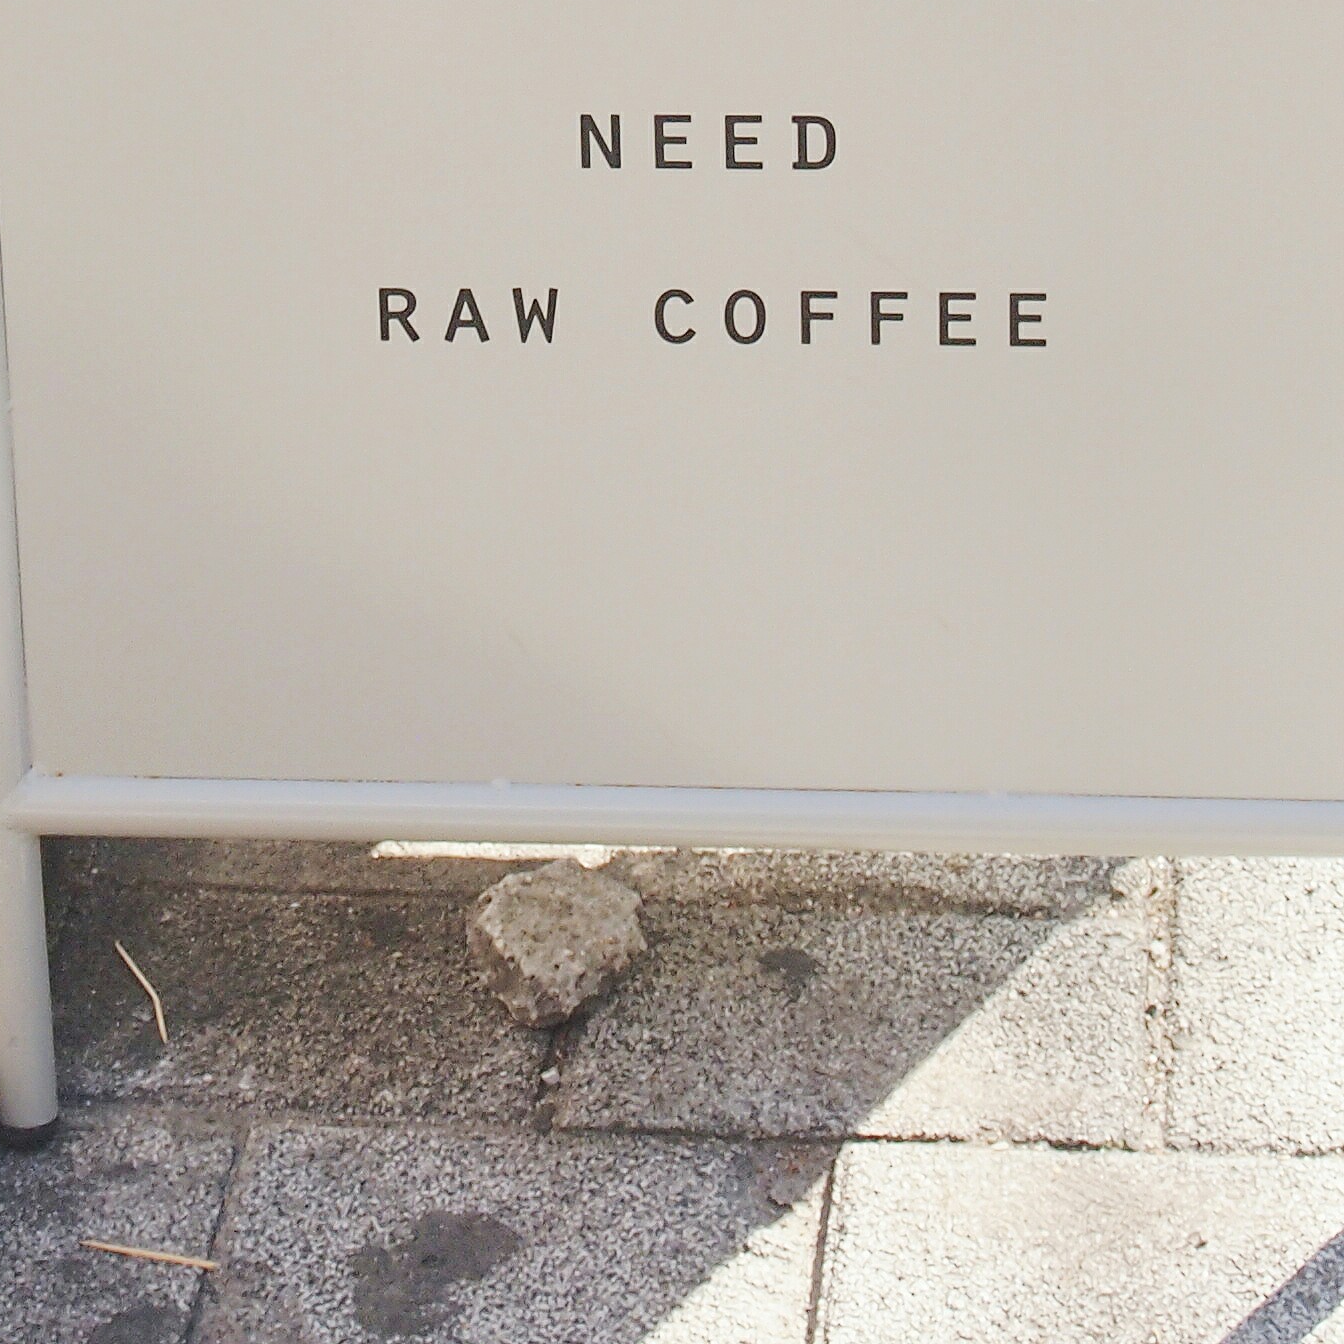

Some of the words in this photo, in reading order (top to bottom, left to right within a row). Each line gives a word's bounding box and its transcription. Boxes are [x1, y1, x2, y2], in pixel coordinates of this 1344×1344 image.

[580, 114, 837, 170] NEED
[379, 287, 559, 344] RAW
[655, 288, 1047, 348] COFFEE
